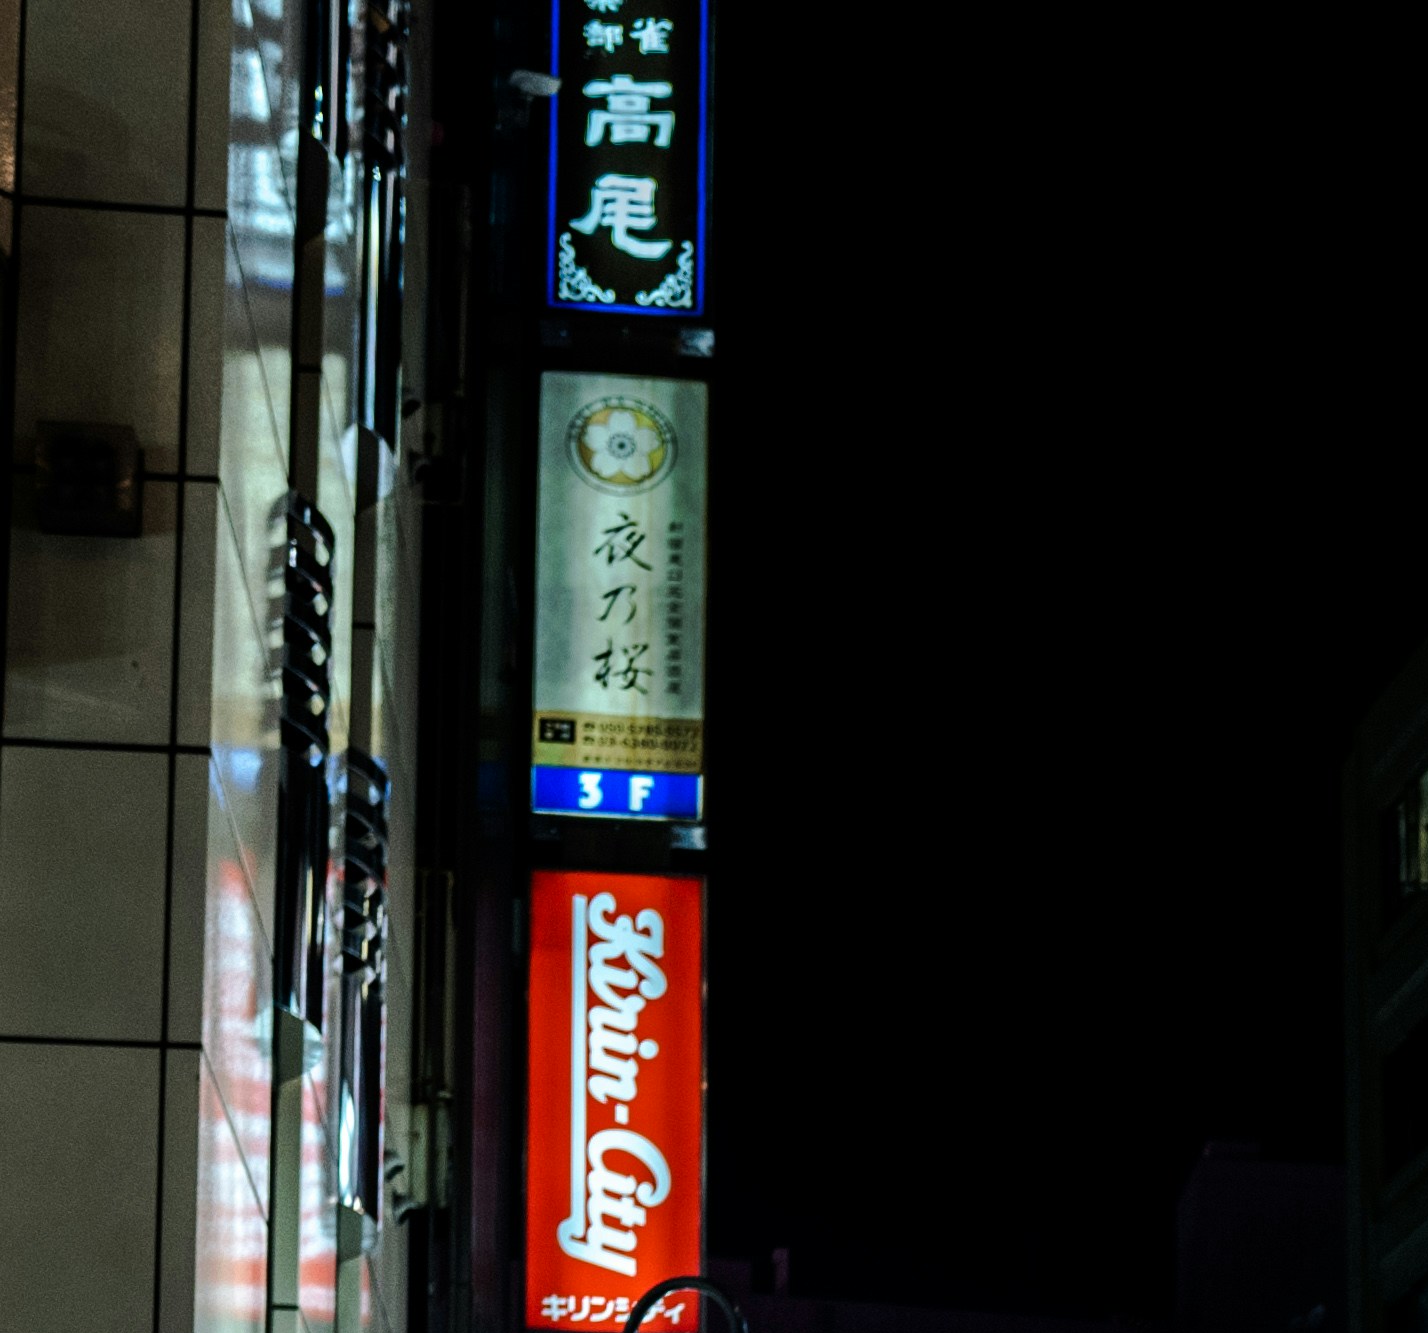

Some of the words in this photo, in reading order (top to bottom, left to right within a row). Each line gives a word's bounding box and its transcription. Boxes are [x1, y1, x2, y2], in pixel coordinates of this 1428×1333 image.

[570, 74, 676, 260] 高尾
[593, 512, 653, 695] 夜乃桜
